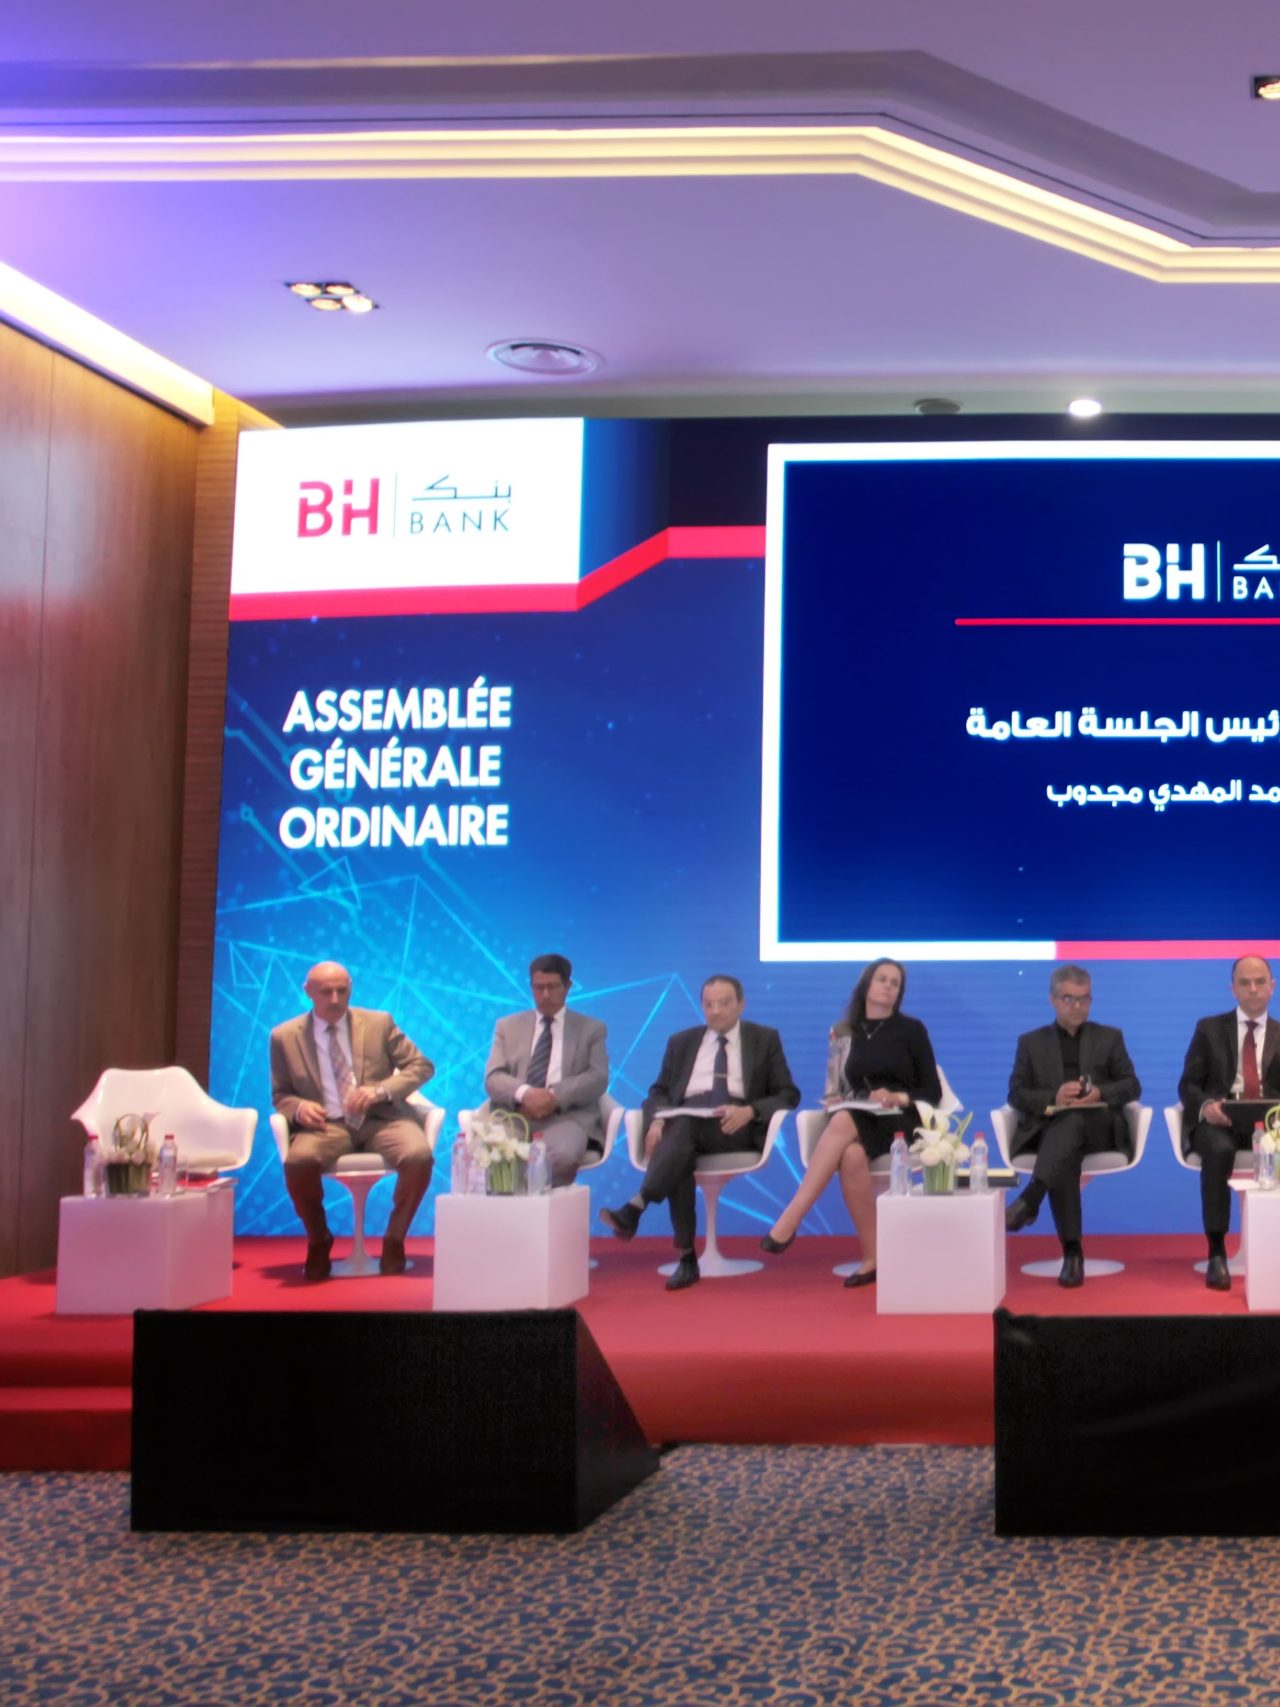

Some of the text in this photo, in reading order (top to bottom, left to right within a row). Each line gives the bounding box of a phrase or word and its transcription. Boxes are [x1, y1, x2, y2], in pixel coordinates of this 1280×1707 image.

[411, 474, 512, 504] بنك
[296, 477, 381, 539] BH
[409, 508, 510, 535] BANK
[1123, 543, 1206, 600] BH
[282, 676, 513, 734] ASSEMBLÉE
[965, 707, 1073, 741] العامة
[1077, 707, 1200, 743] الجلسة
[289, 738, 502, 791] GÉNÉRALE
[1045, 784, 1144, 808] مجدوب
[1147, 778, 1242, 812] المهدي
[278, 803, 510, 849] ORDINAIRE
